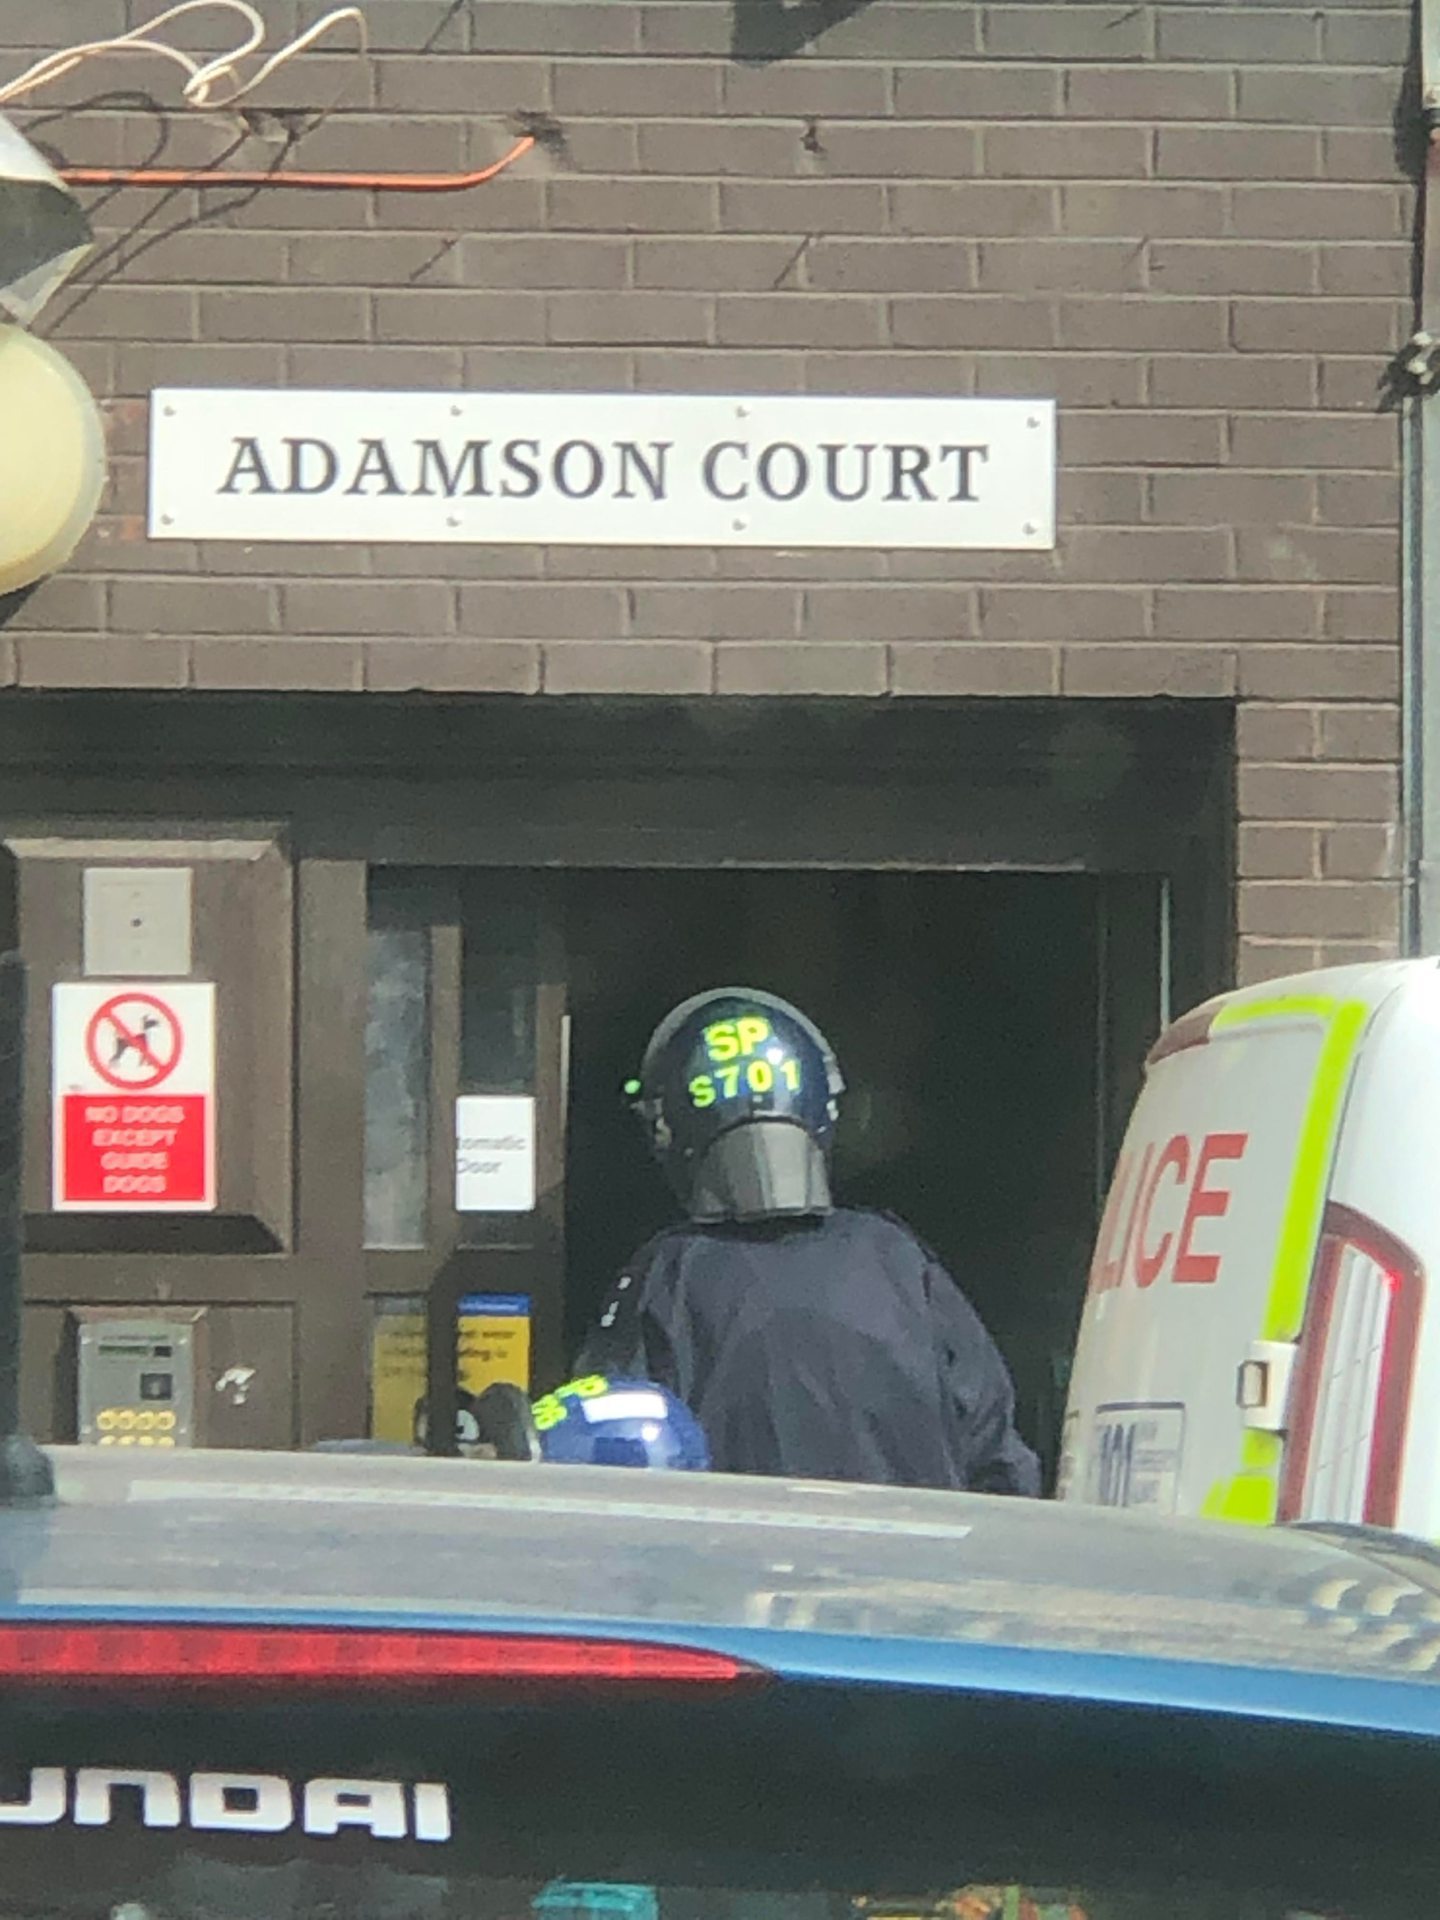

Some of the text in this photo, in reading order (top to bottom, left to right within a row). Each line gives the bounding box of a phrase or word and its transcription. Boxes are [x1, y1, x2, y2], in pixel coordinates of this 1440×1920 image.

[217, 437, 989, 503] ADAMSON COURT
[704, 1017, 769, 1061] SP
[688, 1059, 801, 1108] S701
[84, 1106, 186, 1124] NO DOGS
[92, 1128, 177, 1147] EXCEPT
[100, 1151, 169, 1170] GUIDE
[102, 1175, 167, 1194] DOGS
